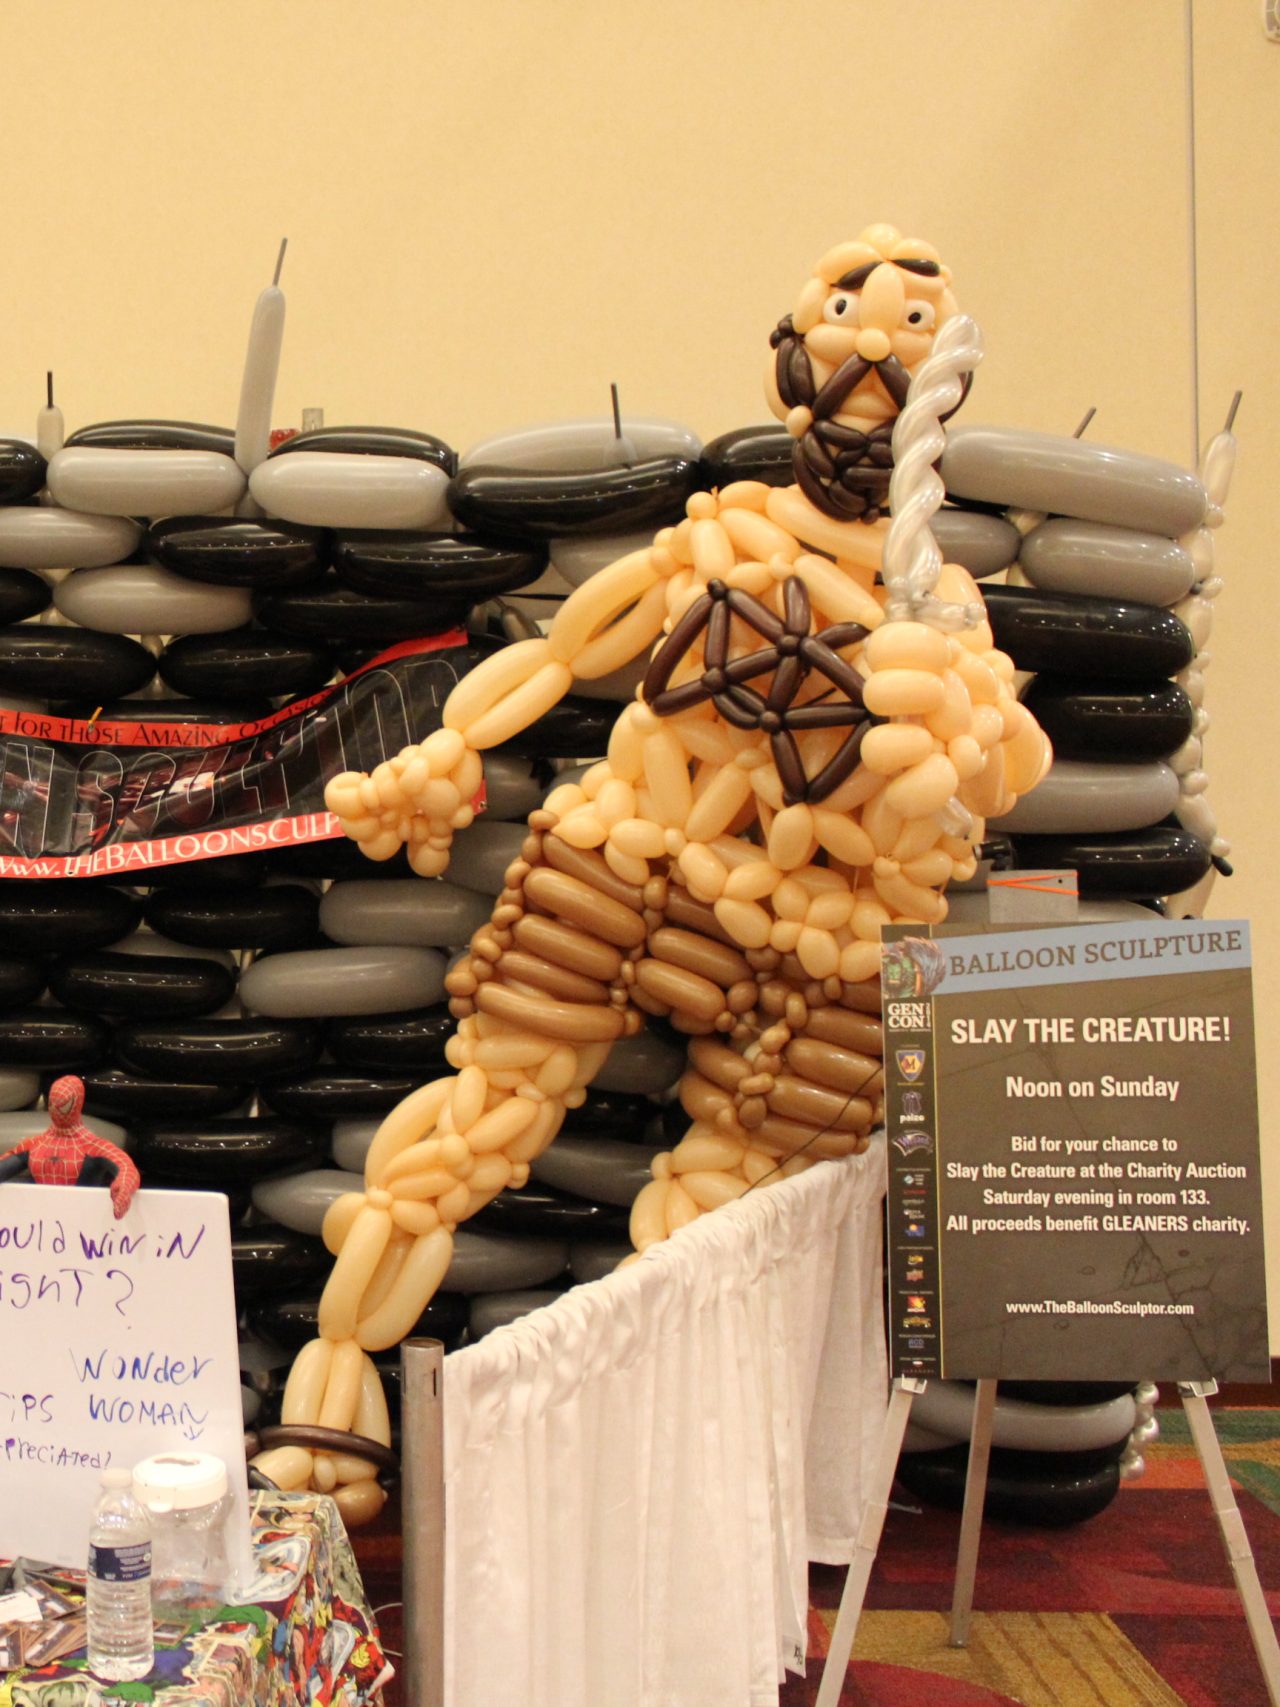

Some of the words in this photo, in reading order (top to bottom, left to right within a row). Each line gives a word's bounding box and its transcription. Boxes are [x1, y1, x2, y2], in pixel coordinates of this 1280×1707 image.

[950, 945, 1076, 976] BALLOON
[1084, 930, 1242, 964] SCULPTURE
[888, 1003, 924, 1016] GEN
[888, 1015, 924, 1028] CON
[951, 1018, 1017, 1043] SLAY
[1023, 1018, 1075, 1043] THE
[1082, 1017, 1230, 1042] CREATURE!
[1006, 1076, 1062, 1097] Noon
[1069, 1081, 1094, 1097] on
[1101, 1075, 1180, 1101] Sunday
[1011, 1136, 1037, 1151] Bid
[1040, 1136, 1062, 1151] for
[1065, 1139, 1099, 1155] your
[1102, 1136, 1158, 1151] chance
[1162, 1137, 1177, 1151] to
[946, 1163, 980, 1180] Slay
[982, 1163, 1007, 1178] the
[1011, 1163, 1076, 1178] Creature
[1080, 1164, 1095, 1178] at
[1098, 1163, 1122, 1178] the
[1127, 1163, 1182, 1181] Charity
[1186, 1163, 1247, 1178] Auction
[983, 1189, 1050, 1207] Saturday
[1054, 1190, 1114, 1207] evening
[1118, 1190, 1132, 1205] in
[1136, 1193, 1176, 1205] room
[1180, 1190, 1210, 1205] 133.
[946, 1216, 968, 1231] All
[972, 1216, 1042, 1234] proceeds
[1046, 1216, 1098, 1231] benefit
[1102, 1216, 1188, 1231] GLEANERS
[1192, 1216, 1251, 1235] charity.
[1005, 1301, 1195, 1318] www.TheBalloonSculptor.com
[90, 1394, 208, 1426] WOMAN
